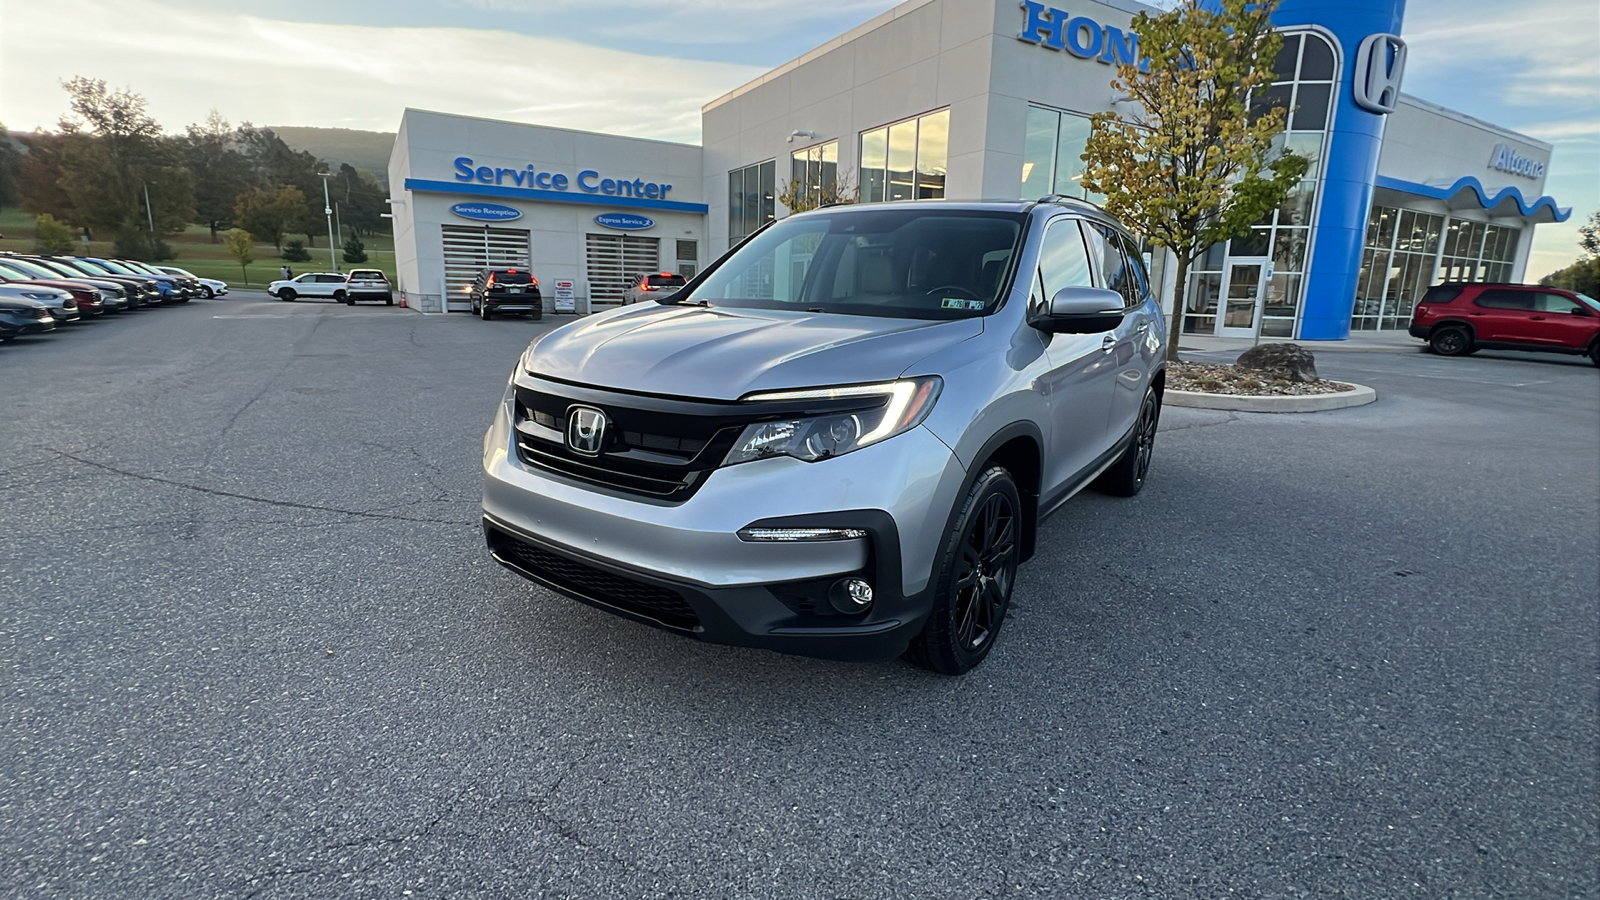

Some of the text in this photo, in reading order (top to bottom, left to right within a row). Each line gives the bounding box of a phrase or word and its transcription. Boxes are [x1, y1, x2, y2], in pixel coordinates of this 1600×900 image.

[454, 156, 673, 199] Service Center
[455, 205, 518, 217] Service Reception
[598, 216, 643, 226] Express Service
